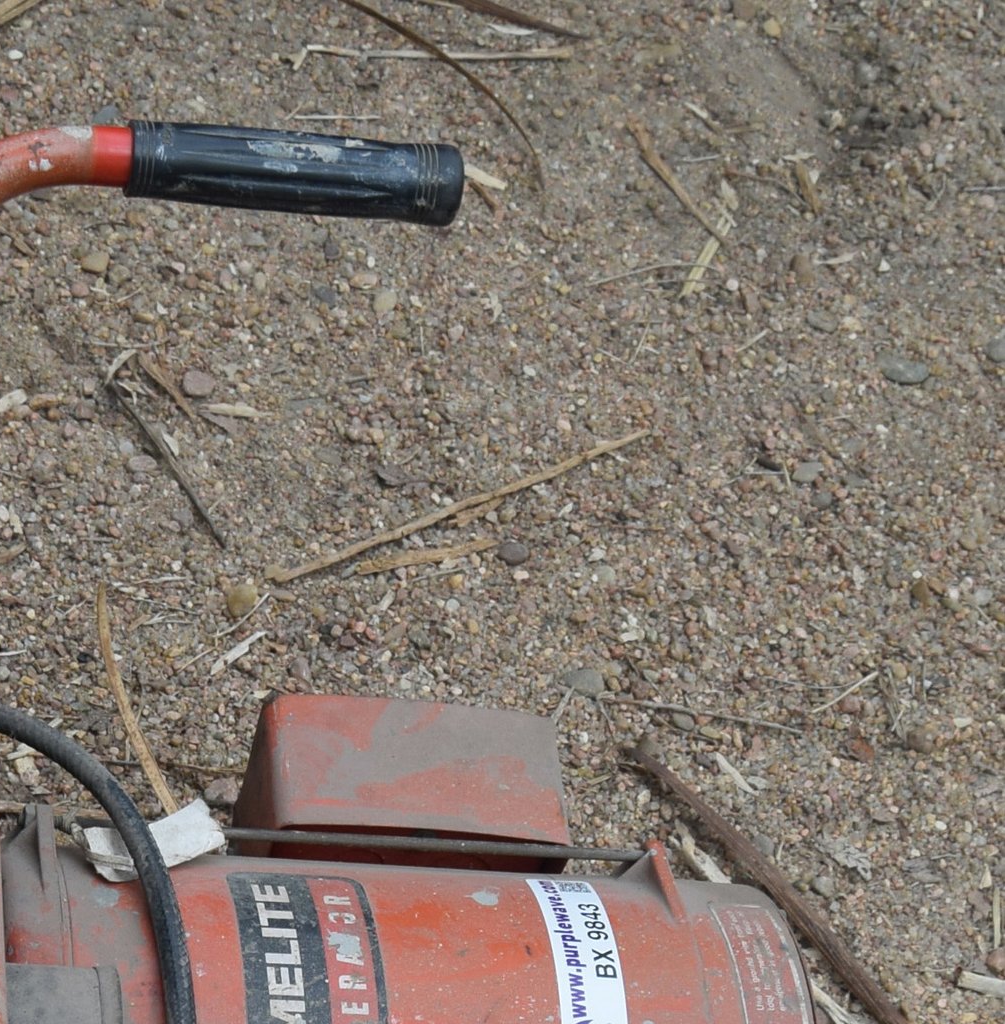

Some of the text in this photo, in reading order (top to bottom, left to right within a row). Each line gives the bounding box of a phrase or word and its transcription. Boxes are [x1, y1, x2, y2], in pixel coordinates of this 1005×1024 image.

[537, 880, 587, 1018] www.purplewave.com
[578, 903, 617, 979] BX 9843
